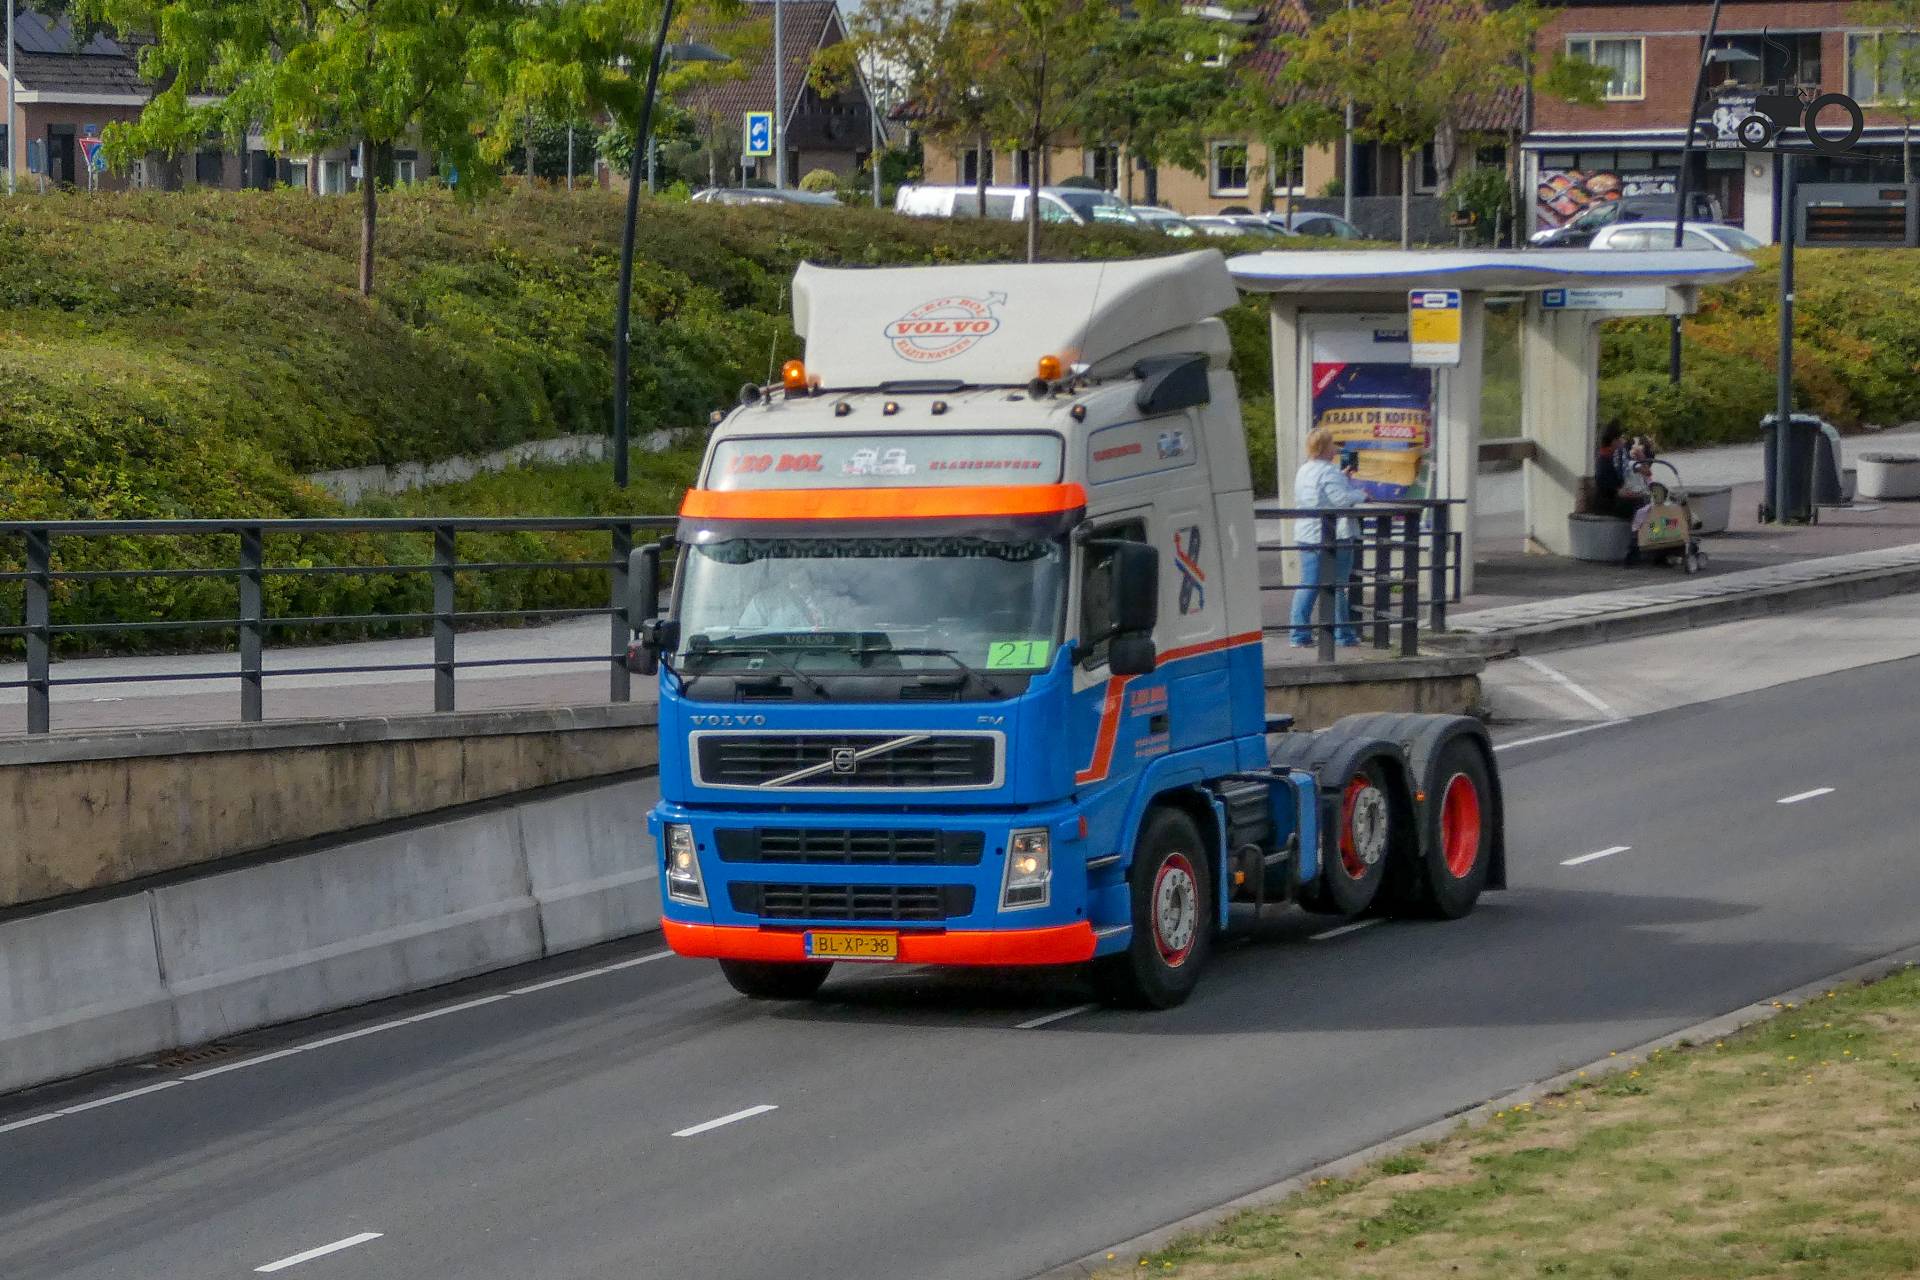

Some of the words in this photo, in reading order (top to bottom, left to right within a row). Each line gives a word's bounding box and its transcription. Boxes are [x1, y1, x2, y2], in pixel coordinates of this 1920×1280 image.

[896, 321, 990, 334] VOLVO
[994, 644, 1036, 666] 21
[690, 716, 766, 725] VOLVO
[818, 936, 890, 953] BL-XP-38
